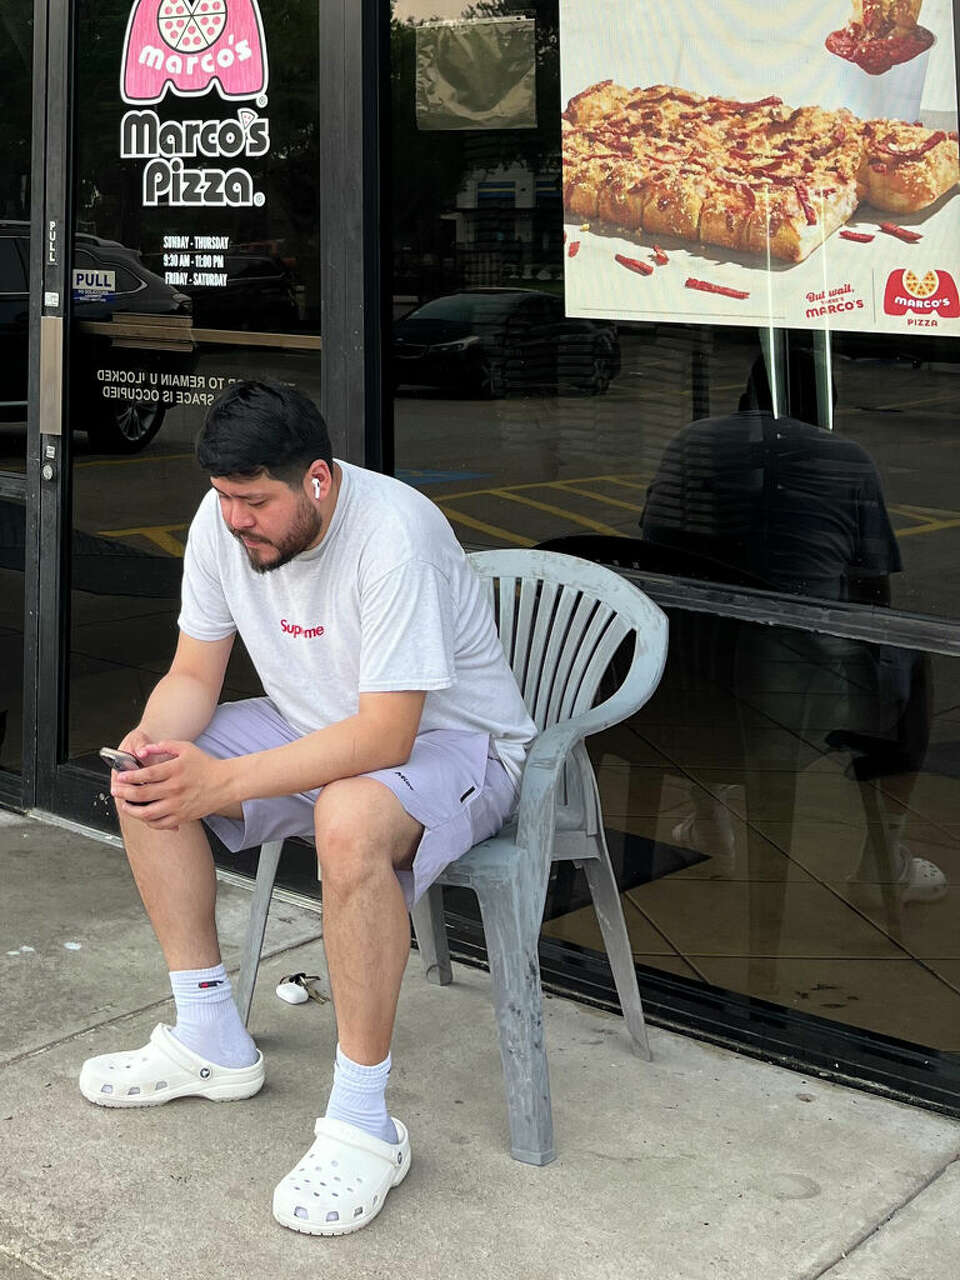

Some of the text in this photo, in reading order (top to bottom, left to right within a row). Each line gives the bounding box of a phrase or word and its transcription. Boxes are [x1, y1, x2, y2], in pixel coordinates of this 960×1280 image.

[120, 108, 270, 159] Marco's
[142, 157, 253, 207] Pizza
[163, 235, 190, 249] SUNDAY
[194, 235, 230, 250] THURSDAY
[179, 254, 190, 268] AM
[213, 254, 224, 268] PM
[76, 273, 112, 288] PULL
[164, 271, 189, 285] FRIDAY
[193, 272, 228, 287] SATURDAY
[805, 290, 826, 303] But
[805, 299, 864, 319] MARCO'S
[907, 319, 938, 327] PIZZA
[280, 619, 324, 639] Supme
